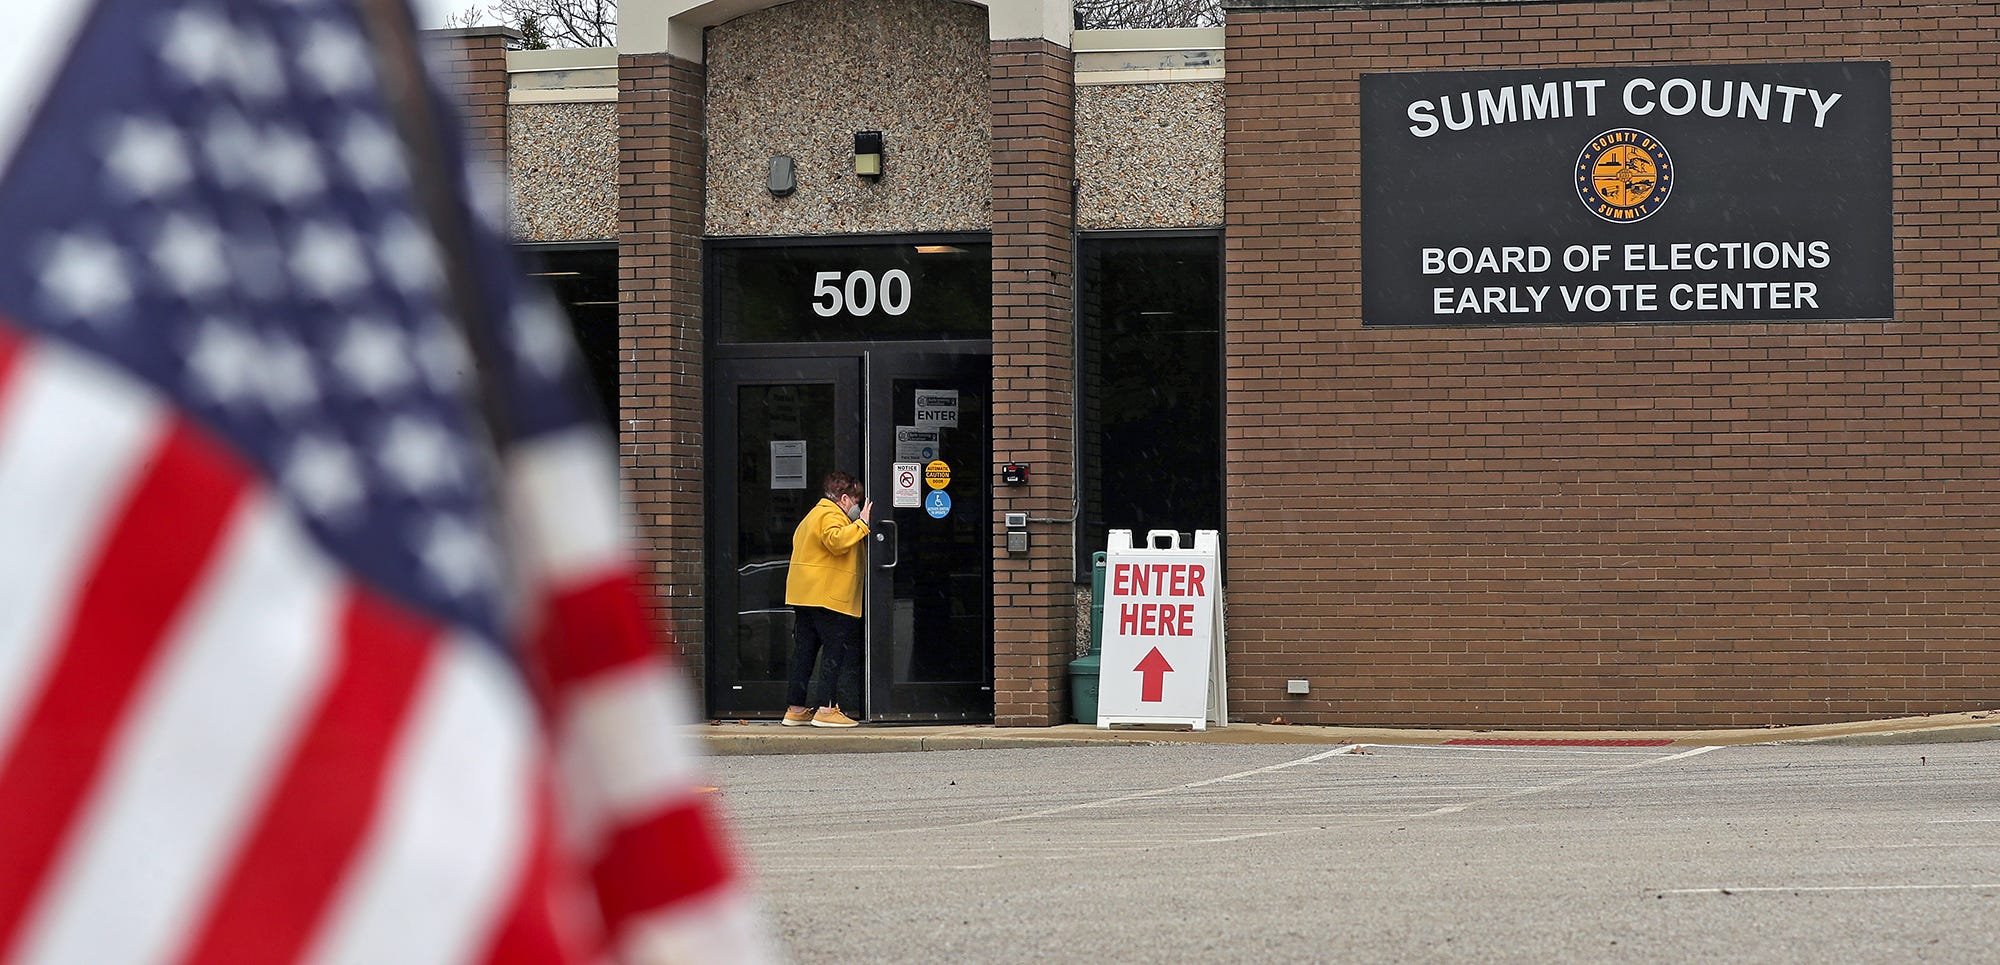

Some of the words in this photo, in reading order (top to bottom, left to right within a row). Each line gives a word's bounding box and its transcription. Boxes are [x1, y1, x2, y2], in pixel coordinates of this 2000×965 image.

[1408, 79, 1606, 138] SUMMIT
[1622, 78, 1843, 129] COUNTY
[1592, 132, 1638, 151] COUNTY
[1642, 138, 1658, 151] OF
[1598, 204, 1648, 219] SUMMIT
[1422, 246, 1551, 275] BOARD
[1563, 244, 1612, 273] OF
[1623, 241, 1831, 272] ELECTIONS
[812, 269, 912, 317] 500
[1433, 286, 1550, 315] EARLY
[1559, 284, 1658, 313] VOTE
[1668, 282, 1820, 312] CENTER
[917, 410, 956, 420] ENTER
[1113, 564, 1206, 597] ENTER
[1119, 603, 1195, 636] HERE
